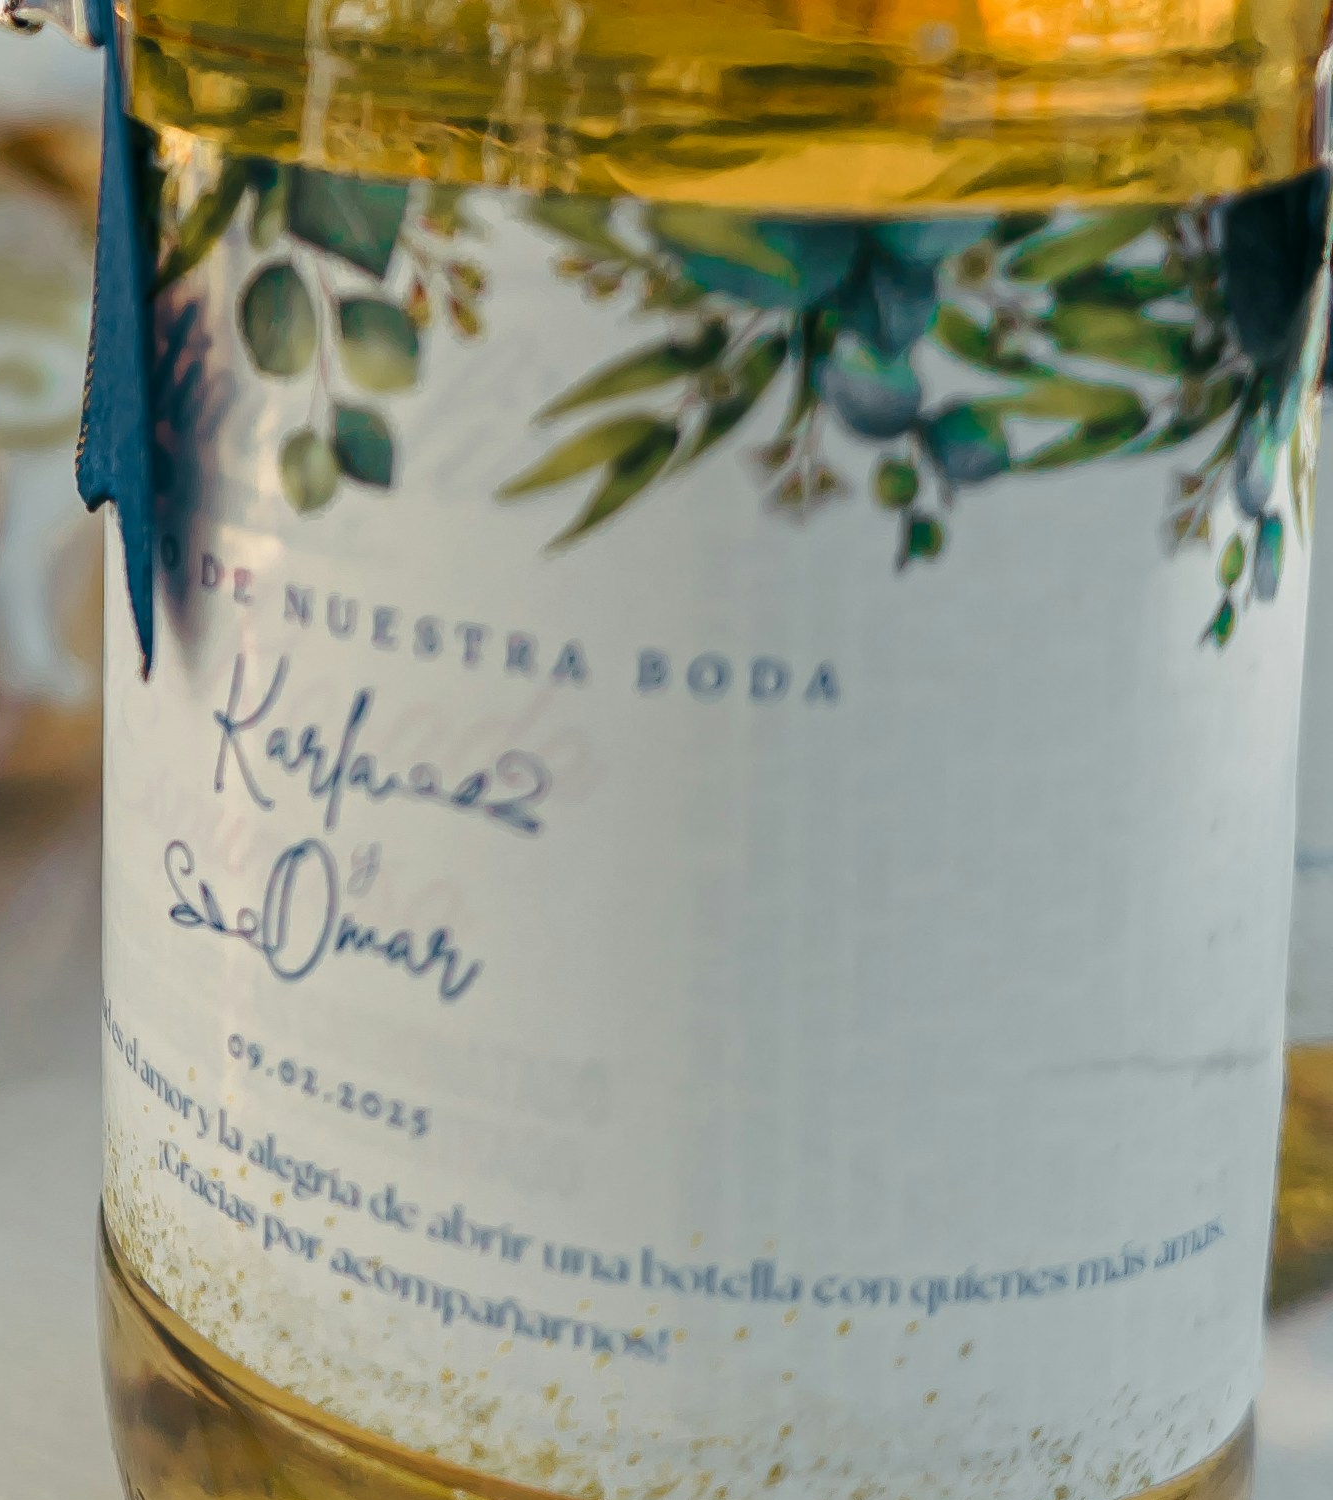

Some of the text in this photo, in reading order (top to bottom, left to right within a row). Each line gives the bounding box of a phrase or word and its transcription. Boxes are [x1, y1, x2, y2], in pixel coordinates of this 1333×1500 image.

[199, 550, 253, 604] DE
[284, 584, 589, 684] NUESTRA
[637, 648, 841, 704] BODA
[165, 837, 485, 1003] Omar
[140, 1059, 194, 1120] amor
[196, 1105, 210, 1139] y
[218, 1109, 244, 1154] la
[369, 1184, 419, 1230] de
[427, 1203, 533, 1263] abrir
[542, 1243, 630, 1284] una
[640, 1245, 805, 1303] botella
[811, 1272, 903, 1307] con
[908, 1264, 1067, 1318] quienes
[263, 1214, 321, 1263] por
